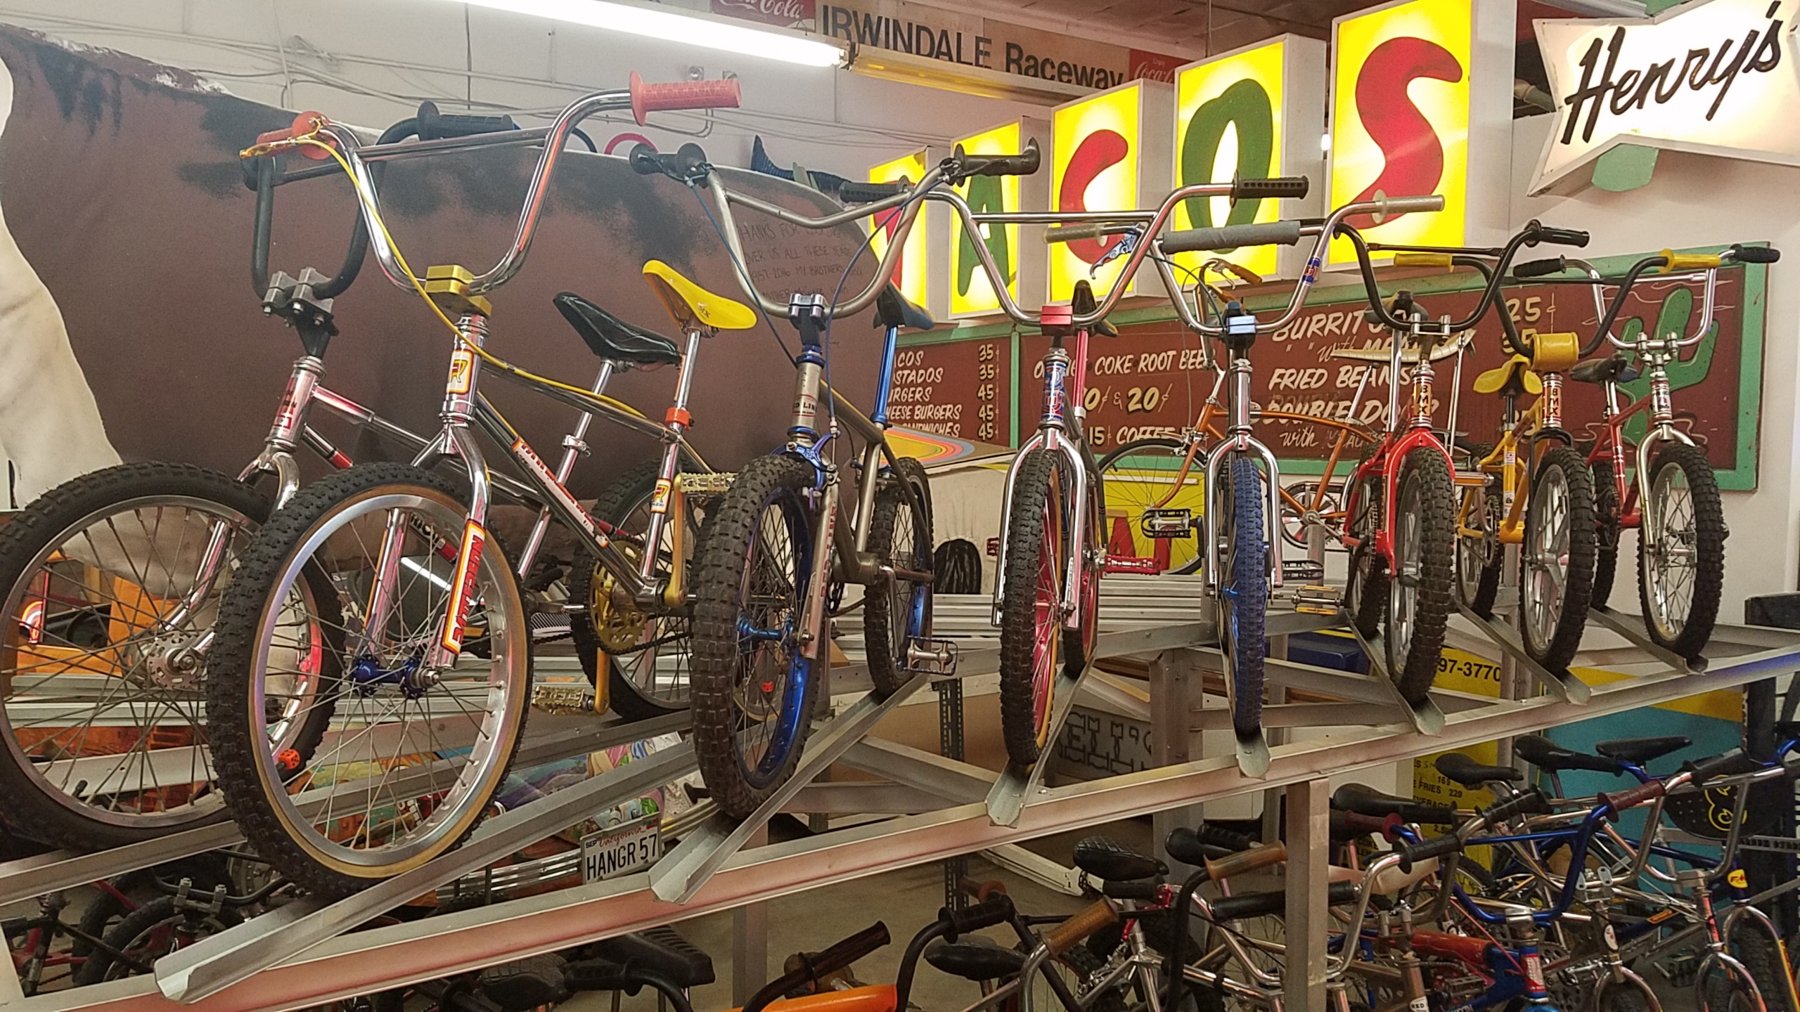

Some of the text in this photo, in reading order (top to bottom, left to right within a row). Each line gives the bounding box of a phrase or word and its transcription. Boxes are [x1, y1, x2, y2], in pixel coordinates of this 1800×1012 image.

[822, 4, 1124, 90] IRWINDALE Raceway
[1562, 0, 1784, 144] Henry's
[1094, 355, 1134, 376] COKE
[1137, 351, 1177, 373] ROOT
[1178, 349, 1216, 370] BEE
[1268, 368, 1328, 391] FRIED
[913, 404, 962, 420] BURGERS
[1280, 425, 1319, 448] with
[586, 833, 657, 881] HANGR 57
